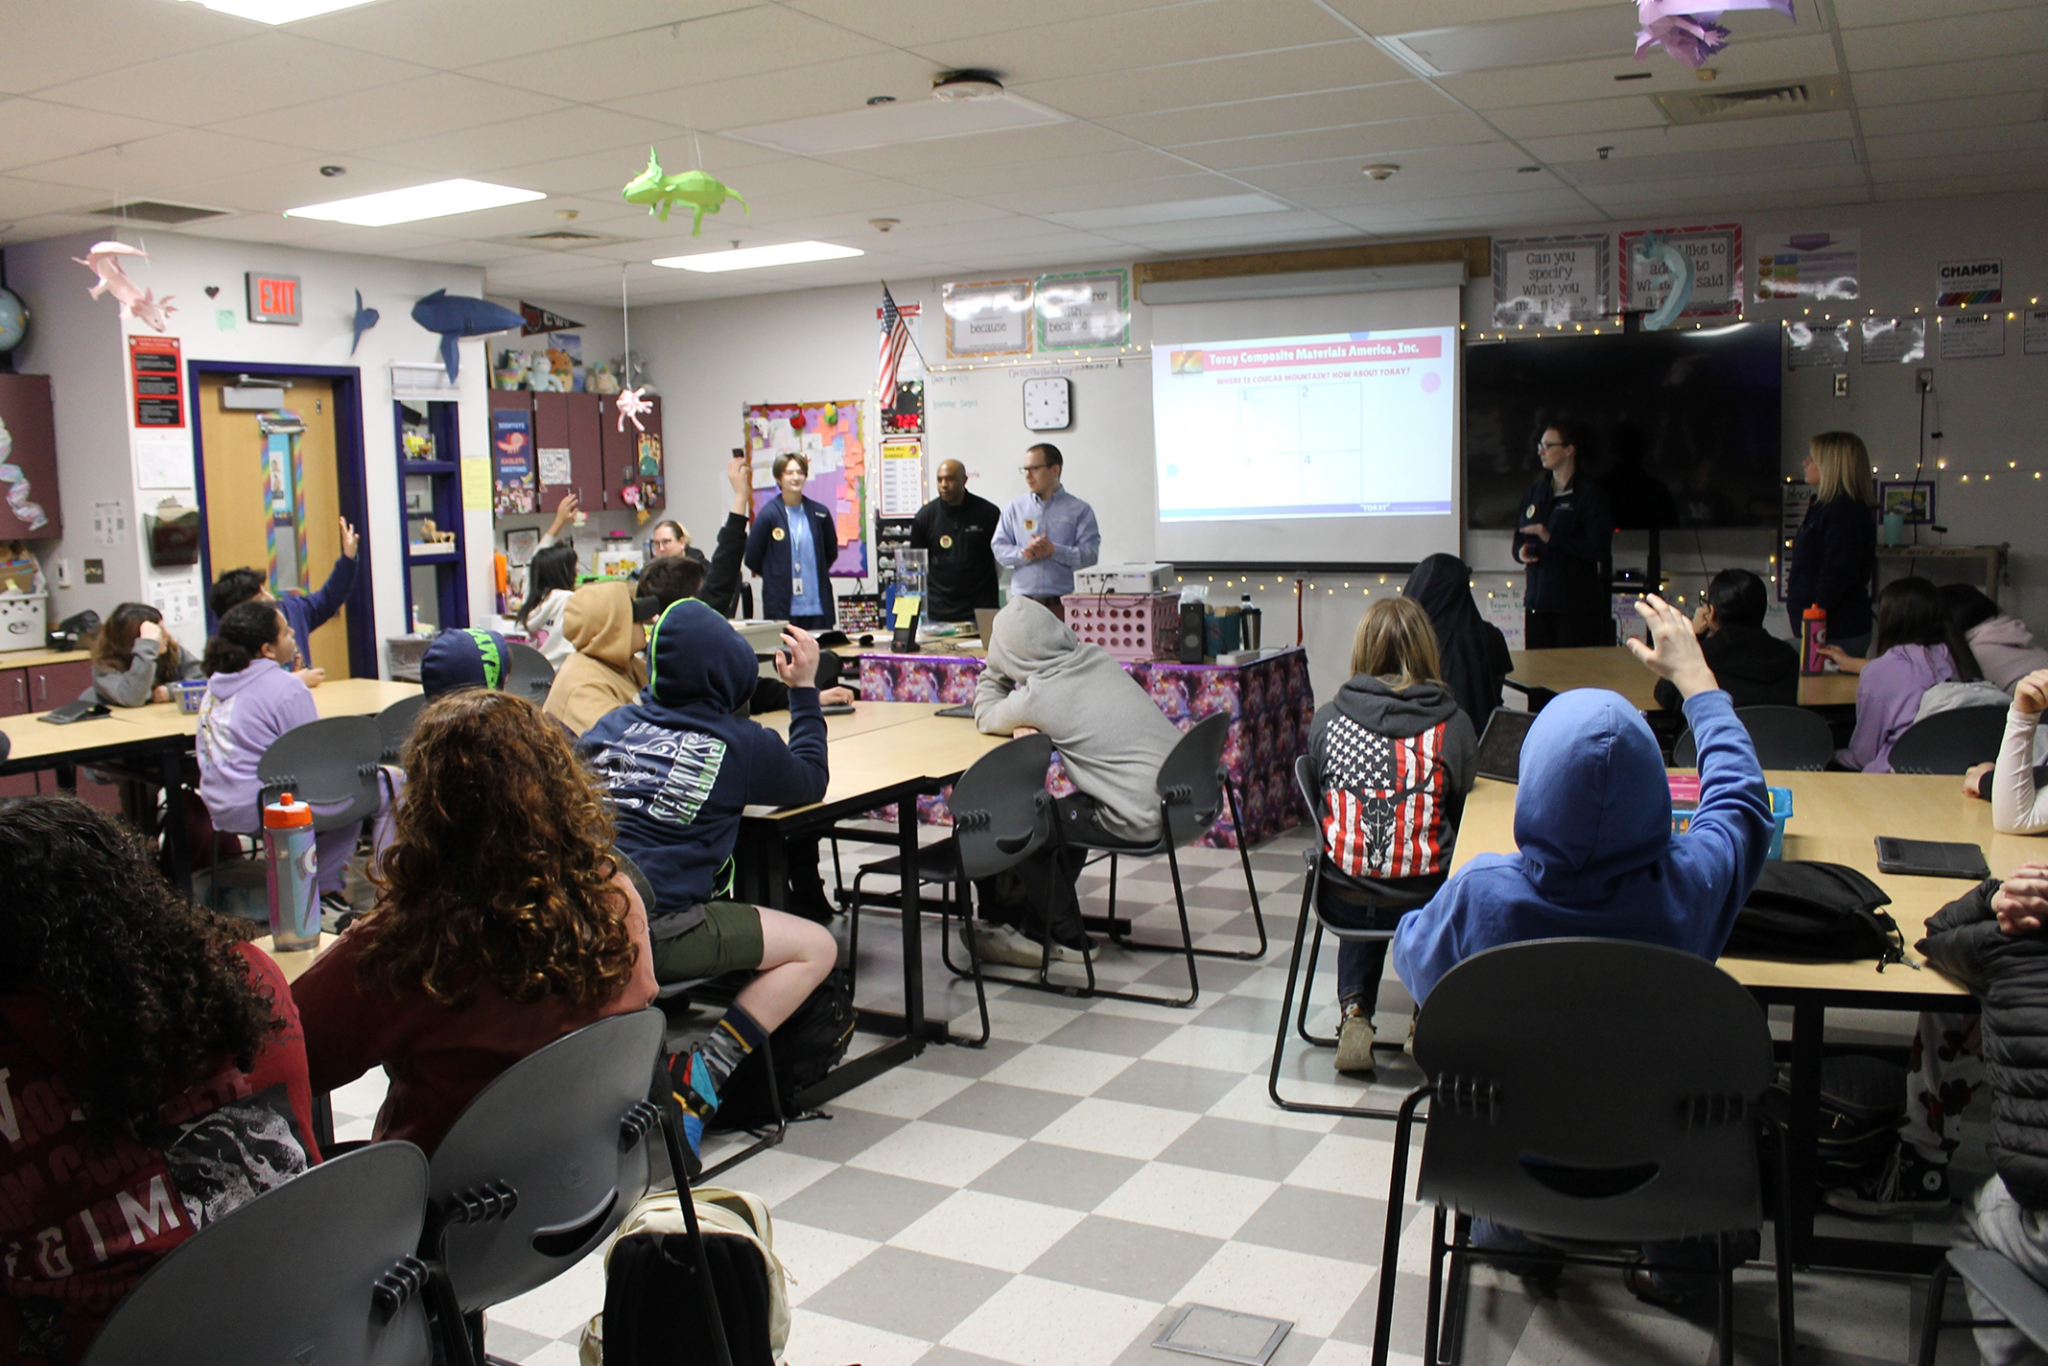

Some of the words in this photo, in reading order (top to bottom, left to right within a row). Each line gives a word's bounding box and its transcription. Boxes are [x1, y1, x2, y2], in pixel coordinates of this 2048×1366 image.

[1685, 243, 1708, 257] like
[1711, 243, 1725, 254] to
[1526, 252, 1551, 266] Can
[1554, 251, 1575, 266] you
[1696, 260, 1710, 272] to
[1528, 266, 1573, 282] specify
[1941, 263, 1999, 278] CHAMPS
[1696, 274, 1723, 288] said
[257, 277, 297, 316] EXIT
[1522, 283, 1555, 296] what
[1557, 282, 1580, 297] you
[970, 322, 1007, 334] because
[1049, 320, 1088, 333] becae
[1209, 353, 1239, 366] Toray
[1240, 349, 1294, 365] Composite
[1296, 345, 1347, 360] Materials
[1348, 343, 1397, 357] America,
[1398, 342, 1420, 354] Inc.
[1217, 376, 1241, 386] WHERE
[1243, 376, 1251, 384] IS
[1252, 373, 1283, 384] COUGAR
[1284, 371, 1330, 382] MOUNTAIN?
[1332, 370, 1352, 379] HOW
[1352, 368, 1379, 378] ABOUT
[1379, 367, 1411, 377] TORAY?
[648, 732, 727, 826] SEAHAWKS
